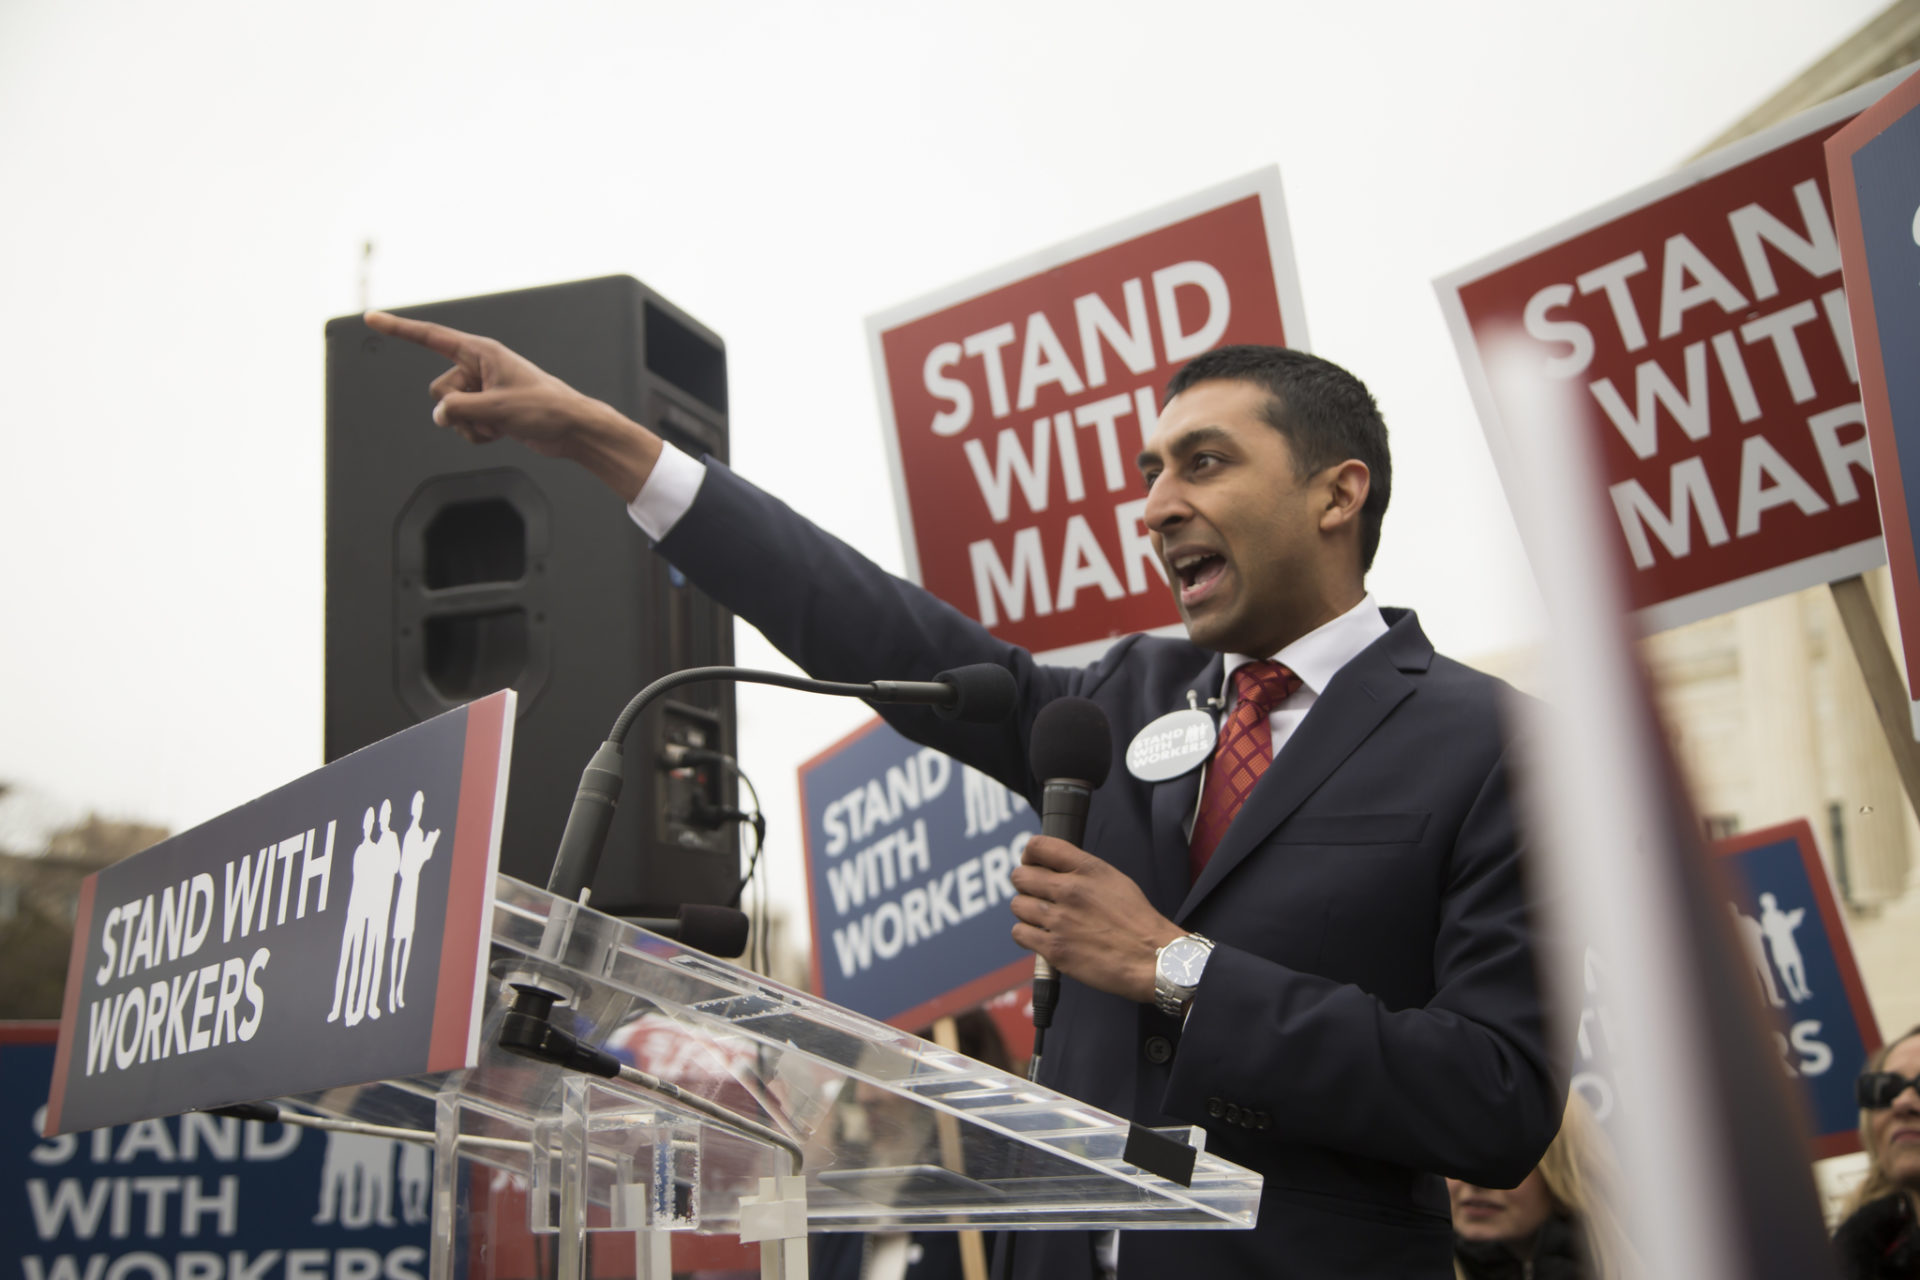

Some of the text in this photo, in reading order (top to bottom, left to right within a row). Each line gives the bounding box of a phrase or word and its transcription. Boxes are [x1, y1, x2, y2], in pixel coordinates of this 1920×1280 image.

[1522, 178, 1844, 380] STAN
[923, 261, 1231, 437] STAND
[1608, 401, 1875, 571] MAR
[969, 497, 1169, 629] MAR
[822, 746, 951, 857] STAND
[1132, 741, 1209, 768] WORKERS
[96, 820, 337, 986] STAND WITH
[826, 819, 931, 914] WITH
[86, 947, 271, 1077] WORKERS
[26, 1175, 240, 1241] WITH
